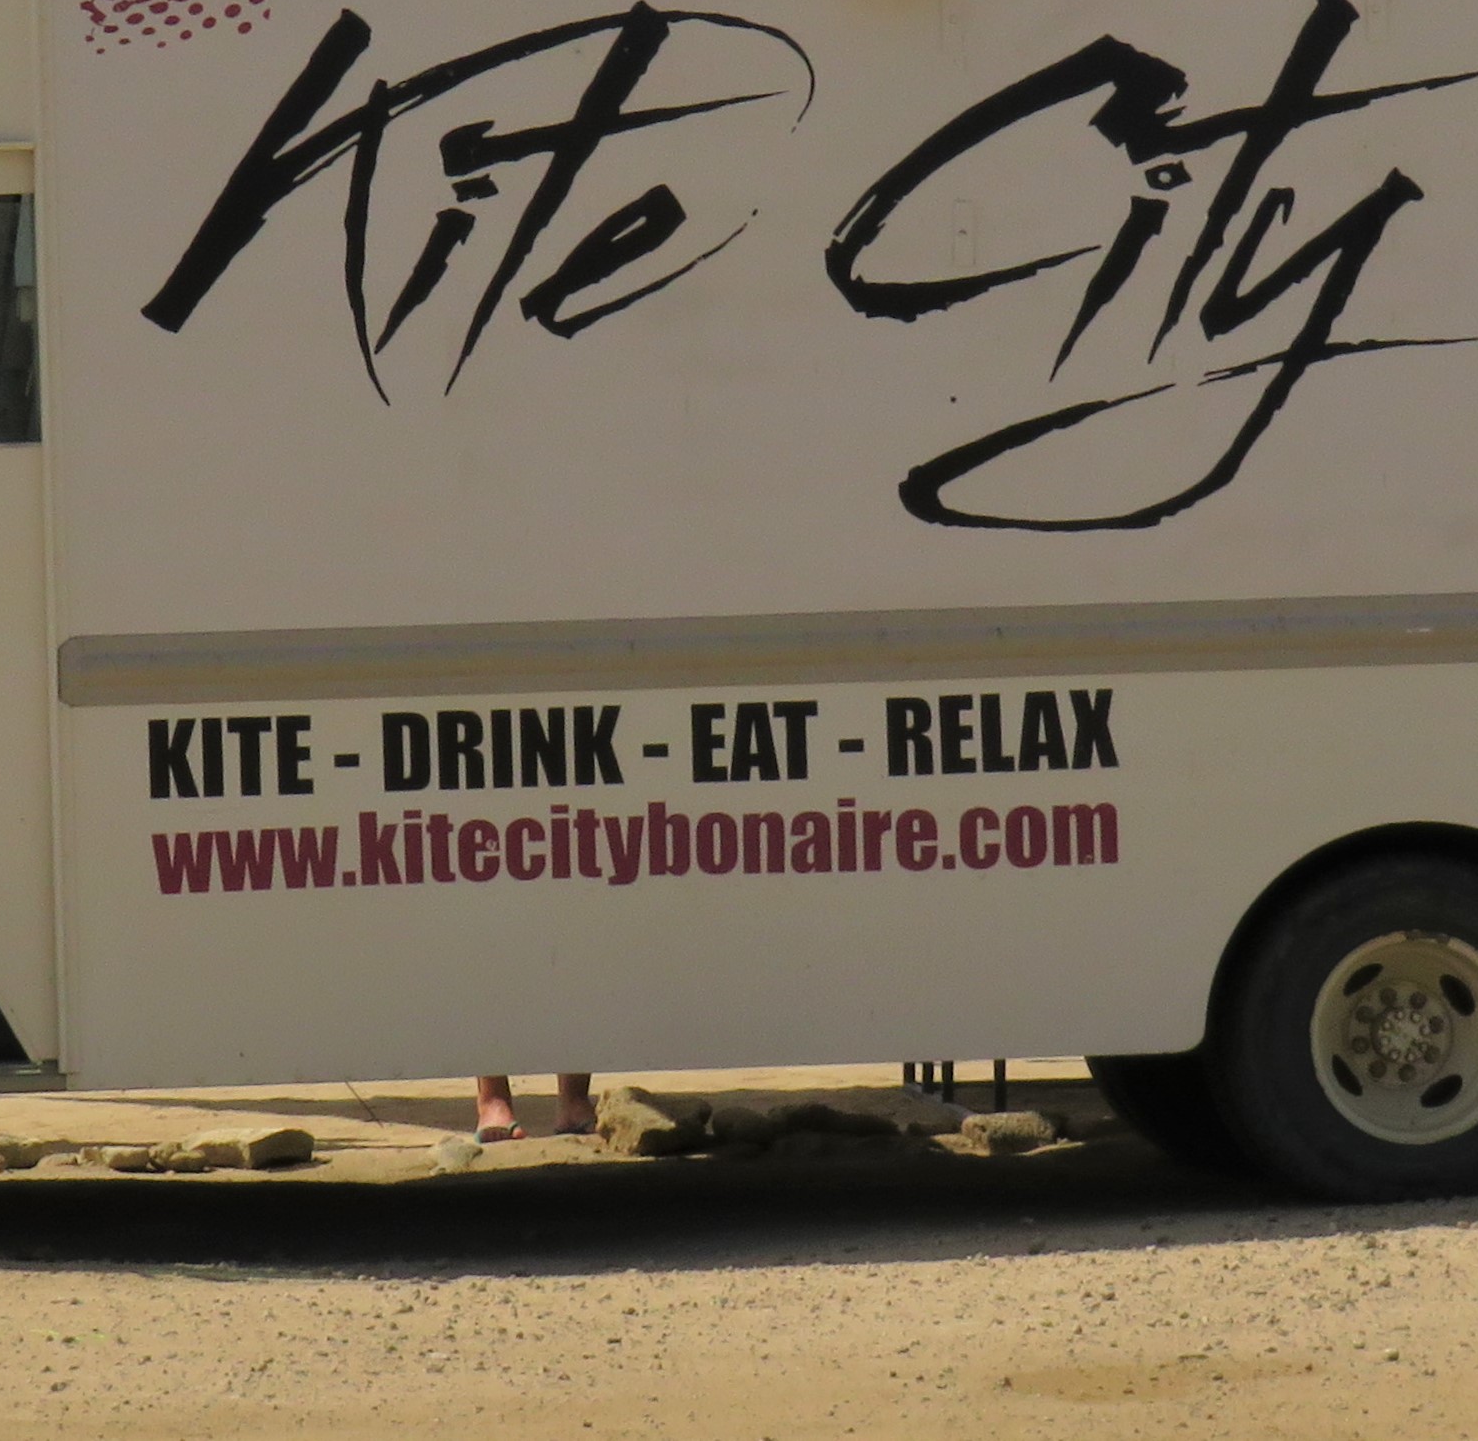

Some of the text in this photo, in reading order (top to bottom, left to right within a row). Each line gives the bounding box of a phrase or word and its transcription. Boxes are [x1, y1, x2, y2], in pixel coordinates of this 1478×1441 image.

[139, 0, 816, 407] Kite
[147, 714, 315, 800] KITE
[381, 705, 625, 793] DRINK
[690, 700, 819, 784] EAT
[885, 688, 1119, 778] RELAX
[151, 797, 1120, 896] www.kitecitybonaire.com
